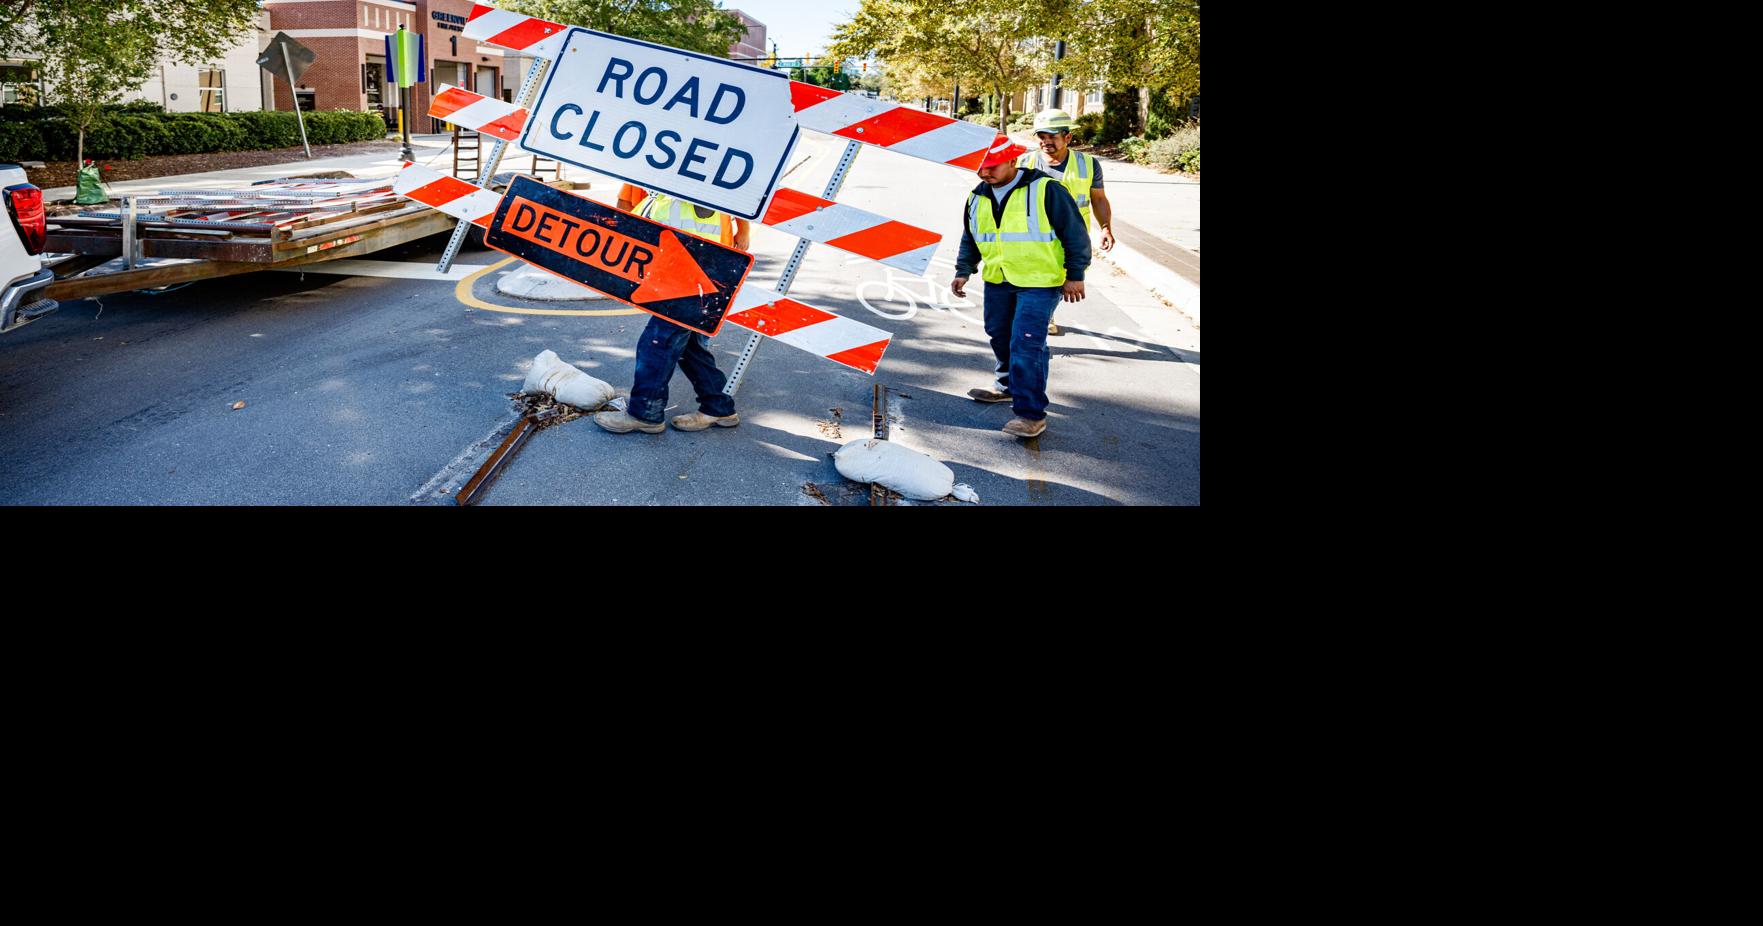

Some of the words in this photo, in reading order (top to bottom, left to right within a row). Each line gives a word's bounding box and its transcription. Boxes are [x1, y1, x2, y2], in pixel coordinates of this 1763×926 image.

[449, 35, 457, 57] 1
[596, 57, 746, 125] ROAD
[549, 103, 755, 190] CLOSED
[511, 204, 654, 279] DETOUR
